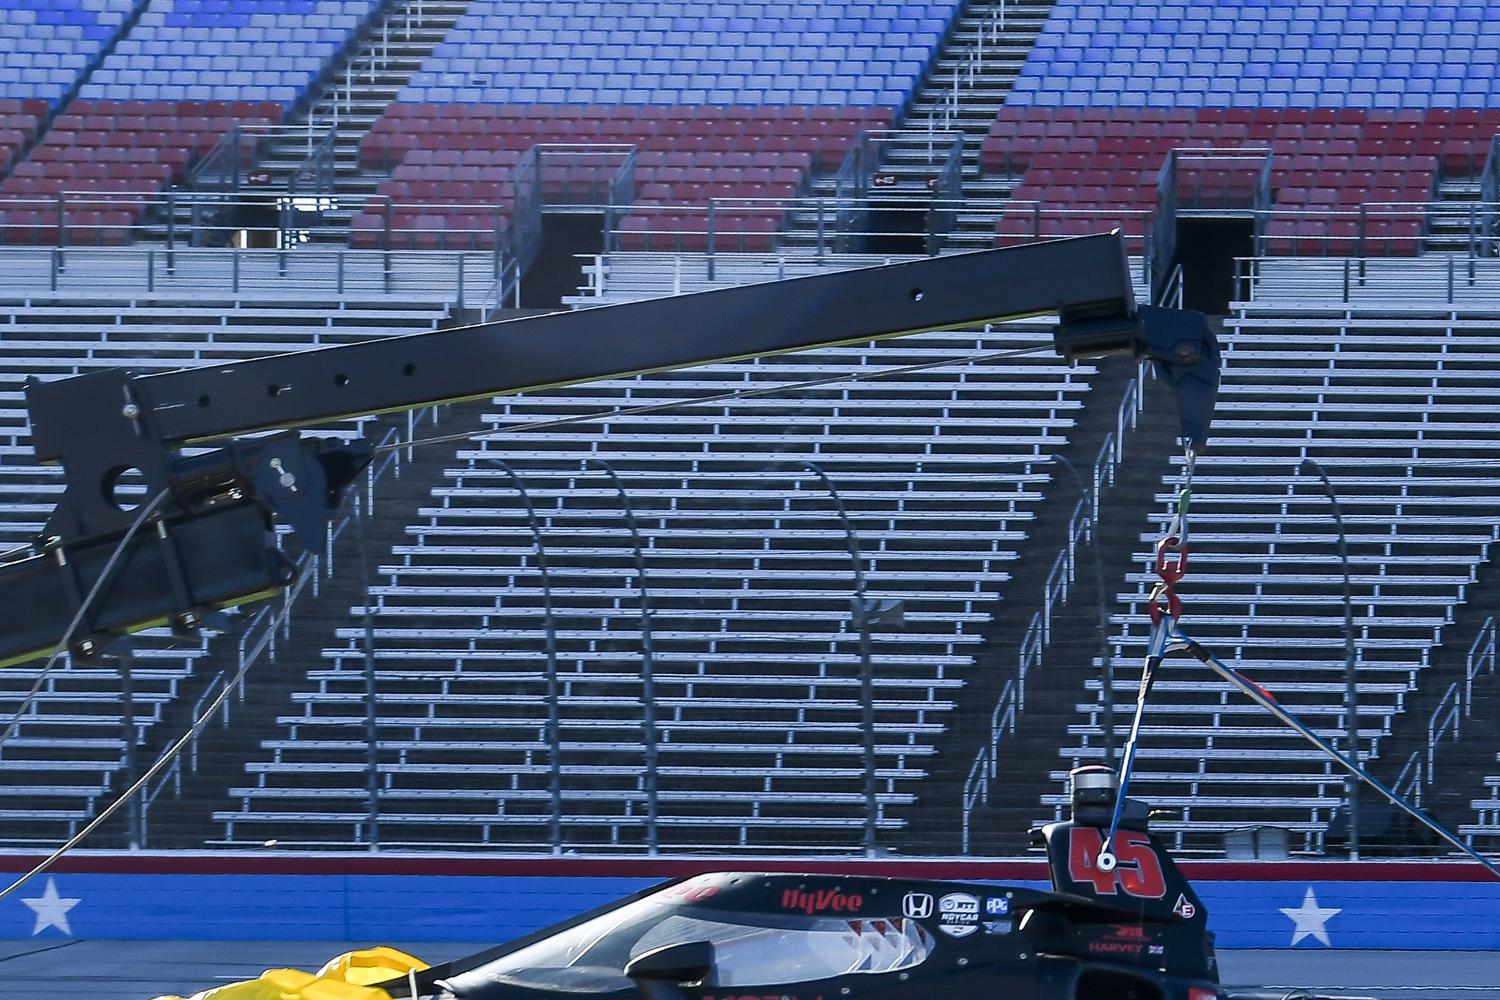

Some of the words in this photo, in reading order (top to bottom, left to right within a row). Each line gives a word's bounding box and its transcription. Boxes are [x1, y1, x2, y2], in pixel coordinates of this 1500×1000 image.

[1069, 827, 1167, 899] 45
[986, 898, 1008, 914] PPG
[1088, 943, 1143, 952] HARVEY
